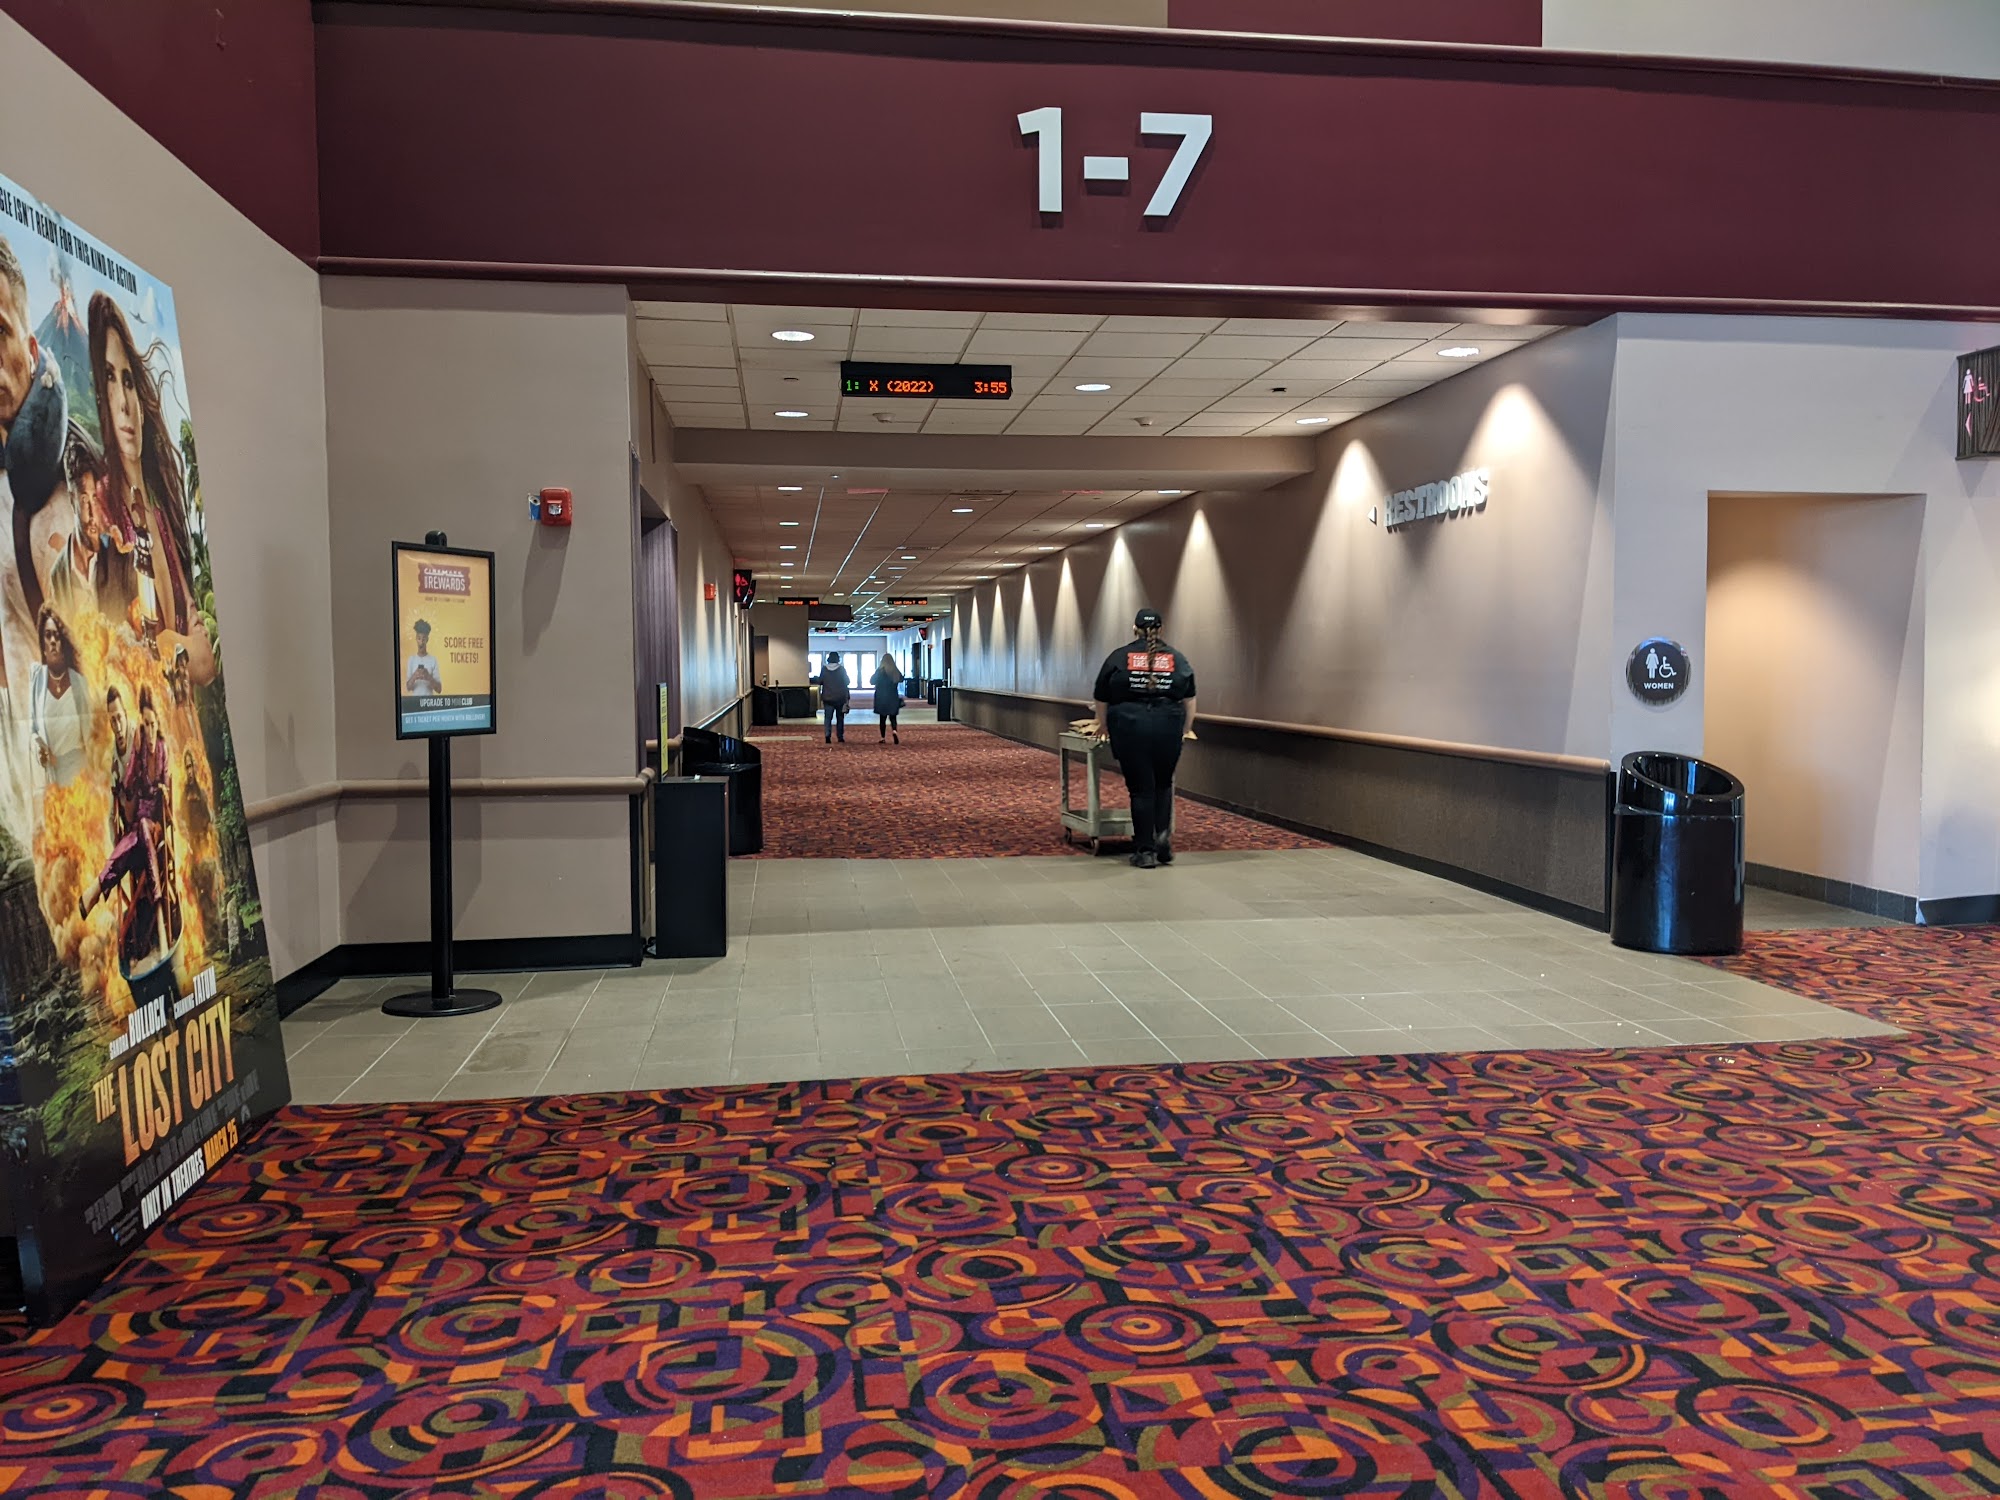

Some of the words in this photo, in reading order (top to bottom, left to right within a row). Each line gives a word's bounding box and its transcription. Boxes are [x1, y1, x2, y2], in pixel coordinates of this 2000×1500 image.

[1016, 106, 1213, 217] 1-7
[13, 195, 35, 231] ISN'T
[35, 210, 59, 246] READY
[59, 226, 74, 256] FOR
[73, 235, 90, 266] THIS
[90, 246, 107, 276] KIND
[107, 257, 116, 282] OF
[115, 263, 138, 296] ACTION
[845, 379, 860, 392] 1:
[869, 380, 879, 392] X
[886, 380, 934, 393] (2022)
[974, 381, 1008, 394] 3:55
[1384, 468, 1489, 527] RESTROOMS
[428, 576, 466, 592] REWARDS
[443, 637, 467, 649] SCORE
[468, 638, 484, 649] FREE
[450, 652, 479, 664] TICKETS!
[420, 697, 444, 708] UPGRADE
[444, 697, 451, 707] TO
[1643, 682, 1675, 690] WOMEN
[193, 965, 217, 1007] TATUM
[128, 994, 167, 1048] BULLOCK
[93, 1072, 116, 1124] THE
[118, 1030, 183, 1167] LOST
[185, 996, 234, 1110] CITY
[141, 1184, 162, 1230] ONLY
[160, 1176, 173, 1212] IN
[170, 1147, 206, 1202] THEATRES
[203, 1125, 229, 1171] MARCH
